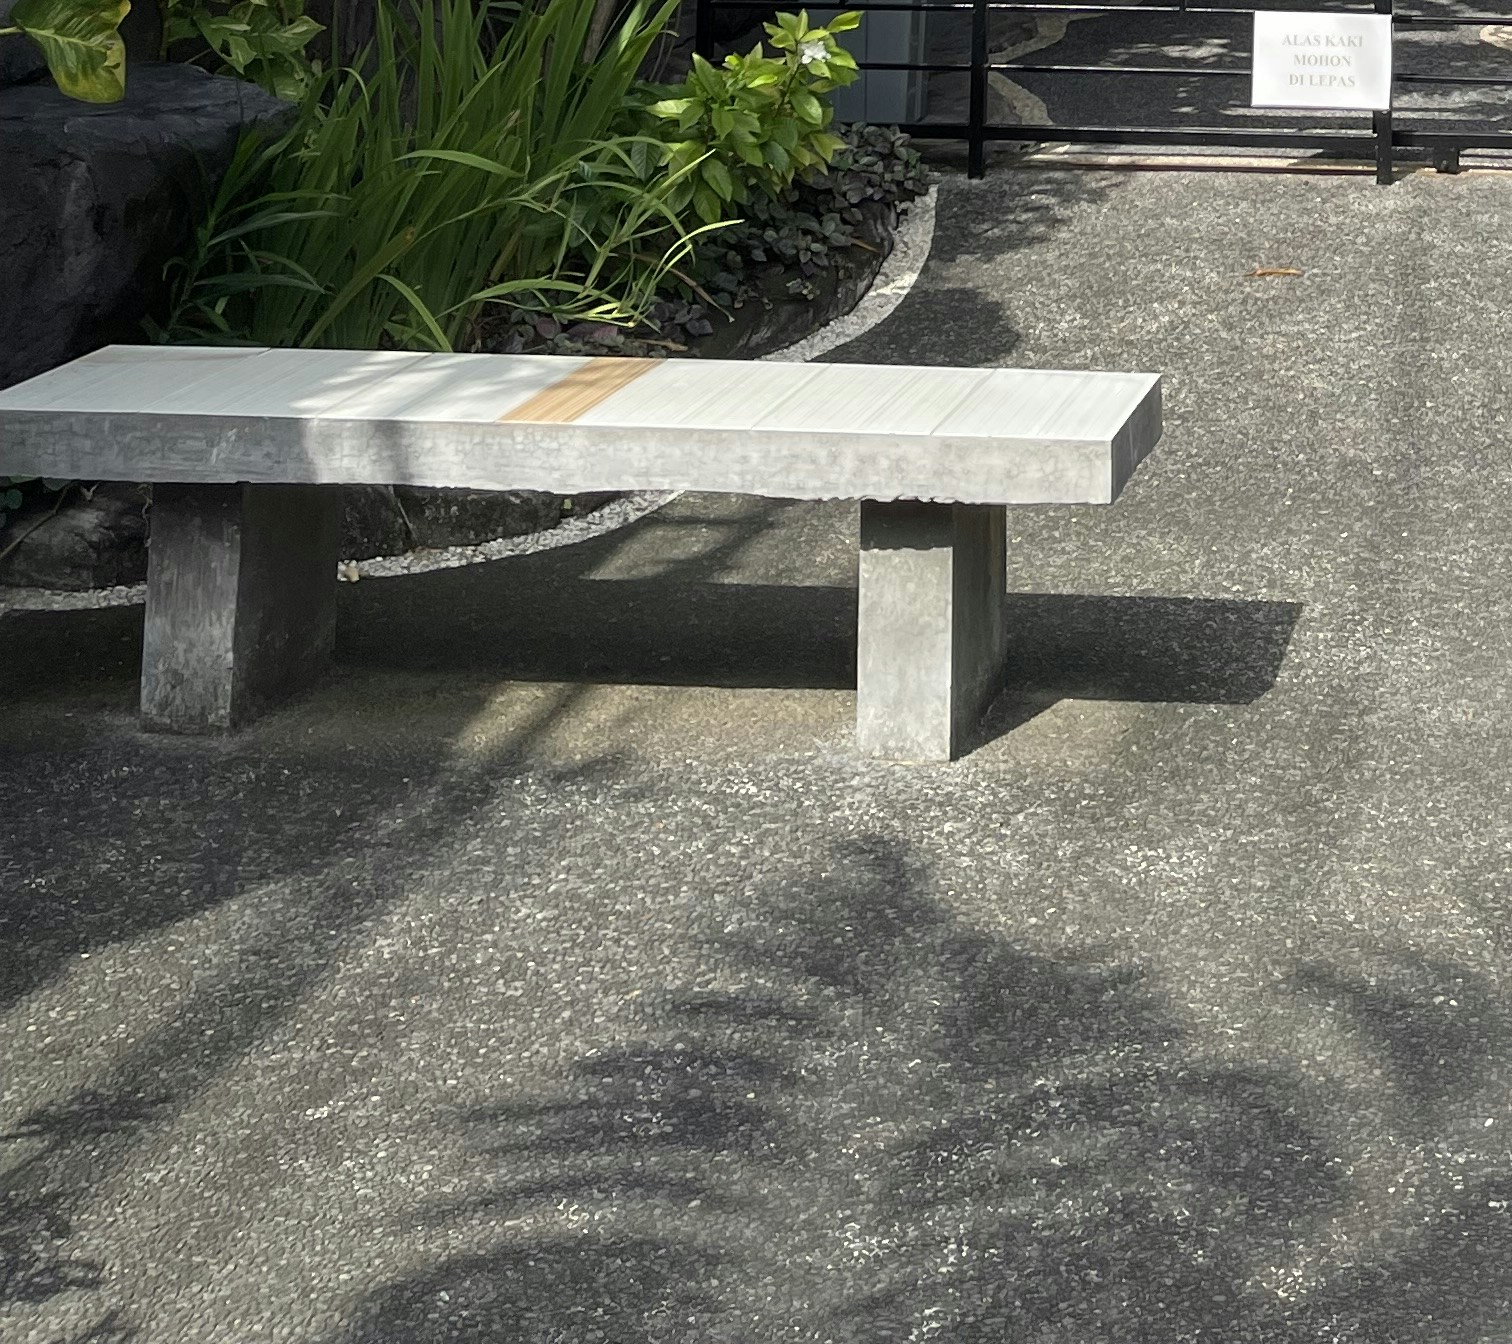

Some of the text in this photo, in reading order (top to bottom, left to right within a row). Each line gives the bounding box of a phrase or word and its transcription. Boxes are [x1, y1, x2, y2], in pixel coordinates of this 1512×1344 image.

[1282, 34, 1363, 48] ALAS KAKI
[1293, 54, 1351, 67] MOHON
[1289, 74, 1356, 88] DI LEPAS
